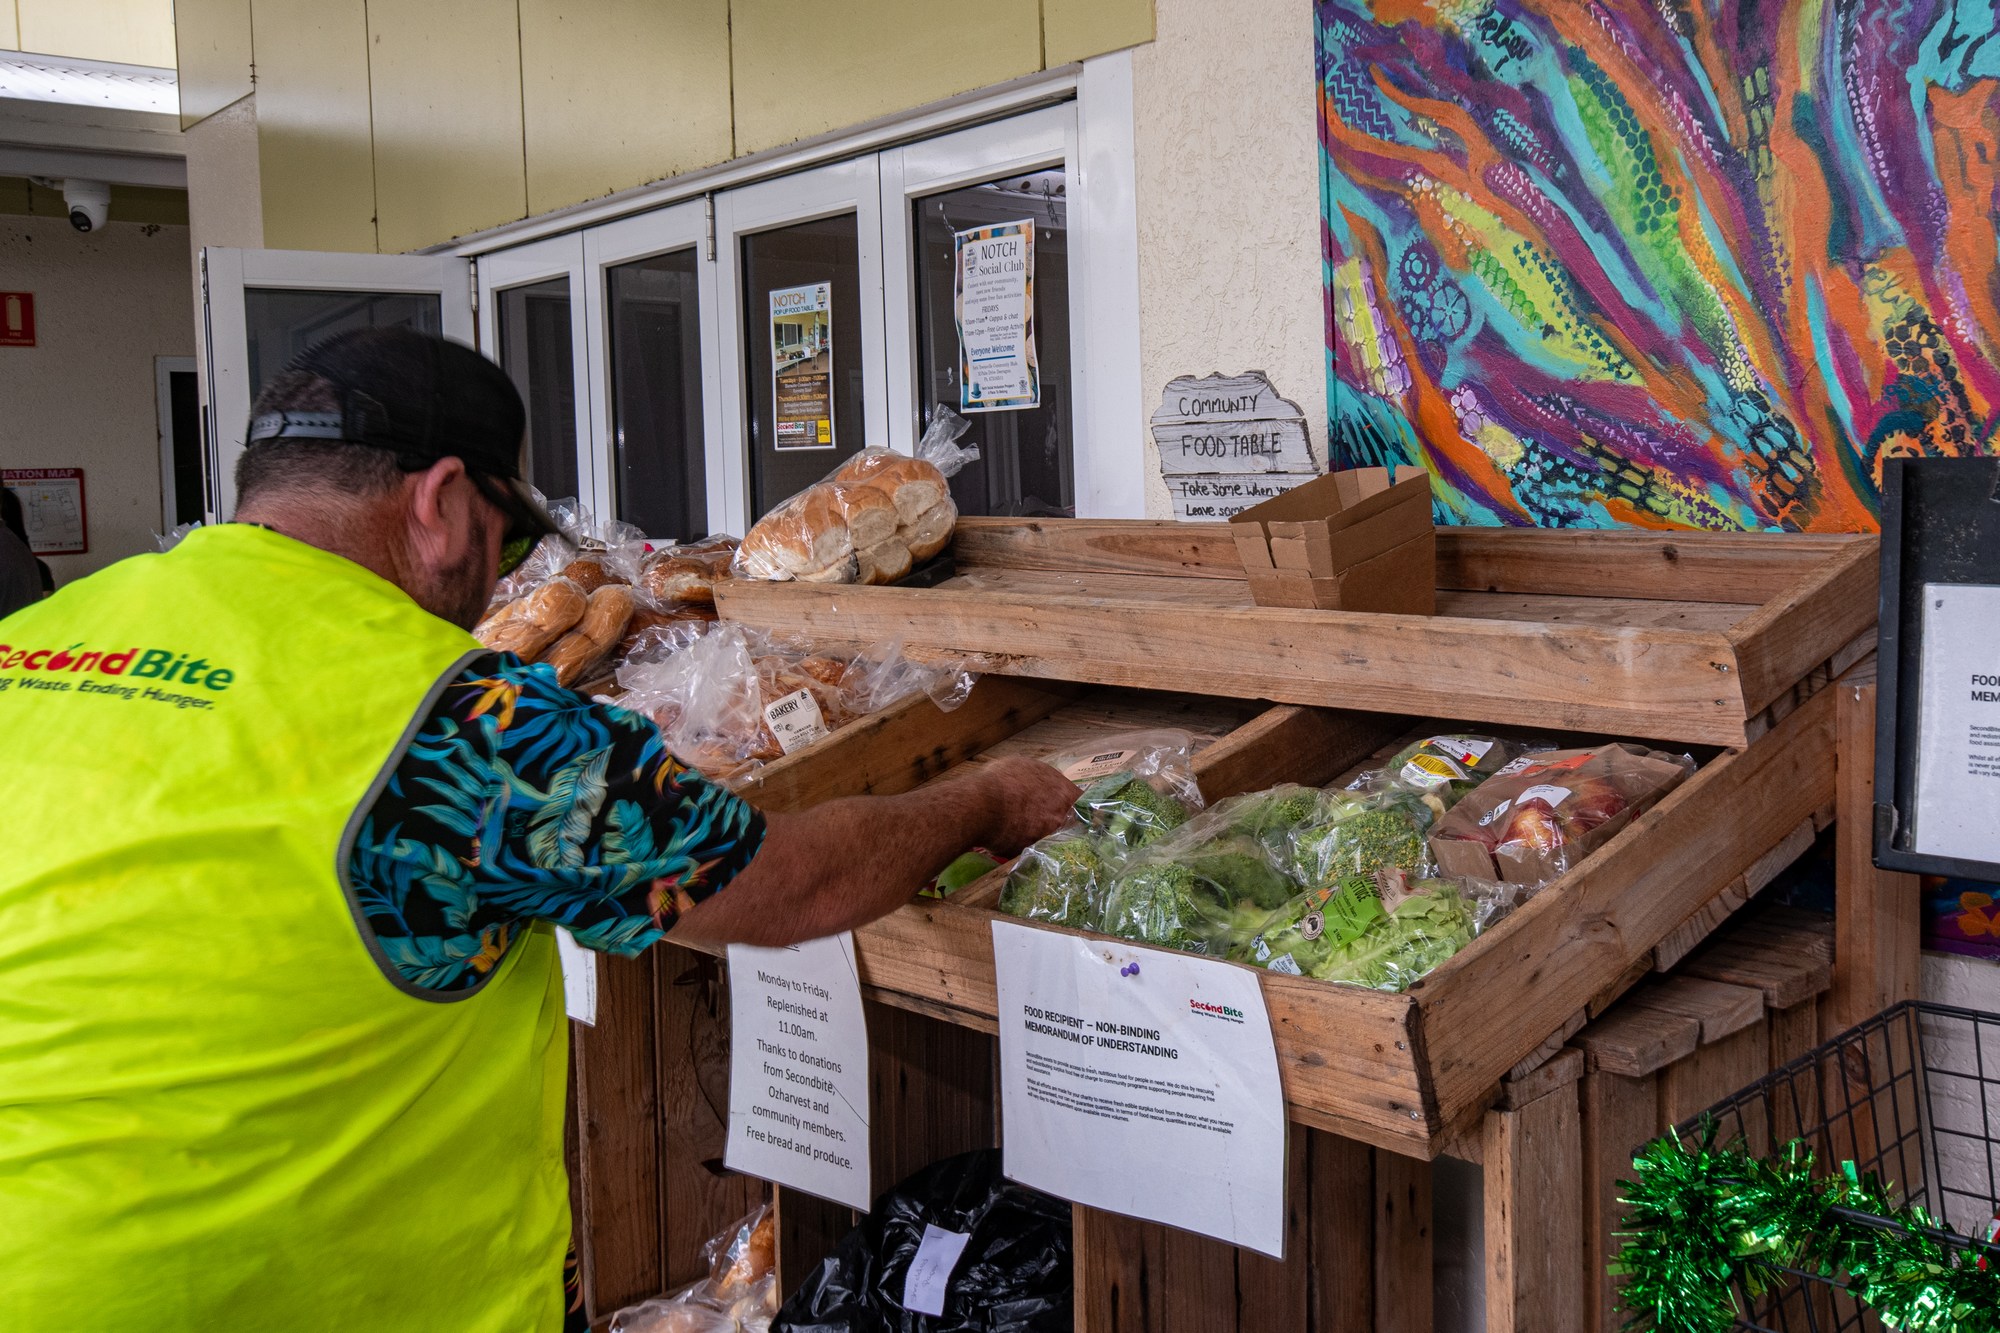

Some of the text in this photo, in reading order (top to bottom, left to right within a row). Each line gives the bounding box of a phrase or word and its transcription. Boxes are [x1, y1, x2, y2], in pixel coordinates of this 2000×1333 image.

[981, 241, 1017, 260] NOTCH
[979, 261, 1002, 276] Social
[1004, 259, 1024, 273] Club
[773, 292, 806, 308] NOTCH
[982, 304, 1000, 314] FRIDAYS
[970, 344, 1015, 356] Everyone Welcome
[1178, 395, 1258, 417] COMMUNTY
[1181, 432, 1283, 458] FOOD TABLE
[48, 470, 75, 478] MAP
[1180, 480, 1209, 497] Take
[1210, 482, 1243, 497] some
[1246, 482, 1274, 497] when
[1186, 504, 1216, 517] Leave
[78, 680, 140, 700] Ending
[141, 687, 215, 710] Hunger.
[770, 700, 800, 720] BAKERY
[757, 970, 833, 1001] Monday to Friday.
[767, 995, 828, 1023] Replenished at
[1190, 999, 1244, 1018] SecondBite
[778, 1020, 818, 1042] 11.00am.
[1024, 1005, 1044, 1020] FOOD
[1044, 1010, 1085, 1030] RECIPIENT
[1096, 1020, 1161, 1041] NON-BINDING
[1024, 1020, 1178, 1060] MEMORANDUM OF UNDERSTANDING
[757, 1038, 842, 1074] Thanks to donations
[763, 1061, 836, 1096] from Secondbite,
[1085, 1074, 1098, 1082] charge
[1104, 1078, 1127, 1087] community
[1127, 1082, 1148, 1090] programs
[1149, 1085, 1171, 1095] supporting
[1187, 1092, 1206, 1102] requiring
[768, 1085, 830, 1115] Ozharvest and
[1196, 1087, 1214, 1096] rescuing
[1081, 1094, 1093, 1102] charity
[1114, 1099, 1124, 1107] fresh
[1139, 1105, 1154, 1113] surplus
[1218, 1120, 1234, 1128] receive
[752, 1104, 847, 1143] community members.
[1166, 1116, 1187, 1125] quantities
[1212, 1126, 1232, 1135] available
[746, 1126, 853, 1171] Free bread and produce.
